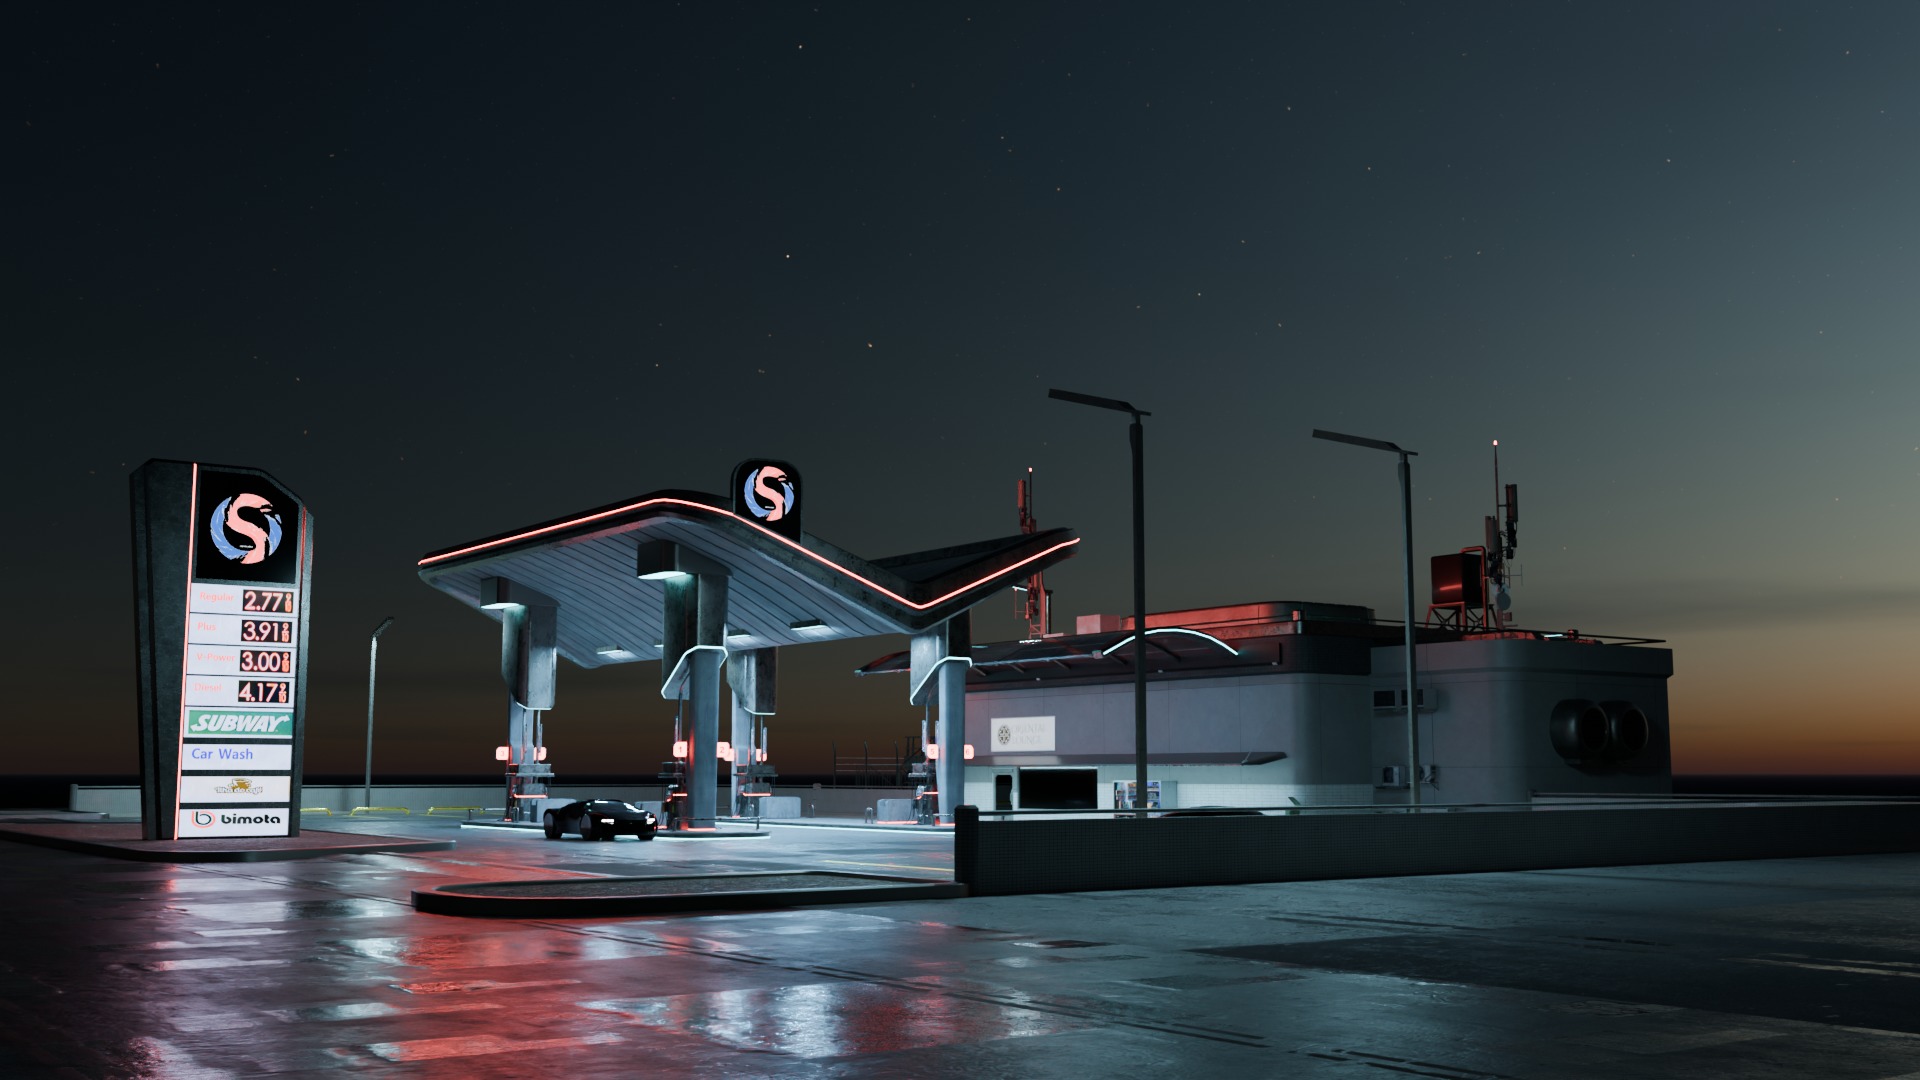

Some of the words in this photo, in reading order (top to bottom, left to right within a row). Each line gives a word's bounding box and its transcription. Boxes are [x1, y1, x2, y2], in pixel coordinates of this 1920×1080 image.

[200, 592, 234, 603] Regular
[244, 591, 283, 612] 2.77
[197, 622, 216, 631] Plus
[242, 621, 279, 642] 3.91
[196, 652, 235, 662] V-Power
[241, 651, 281, 671] 3.00
[194, 683, 223, 692] Diesel
[239, 681, 278, 702] 4.17
[190, 714, 290, 732] SUBWAY
[191, 748, 213, 759] Car
[218, 748, 253, 760] Wash
[221, 813, 281, 824] bimota
